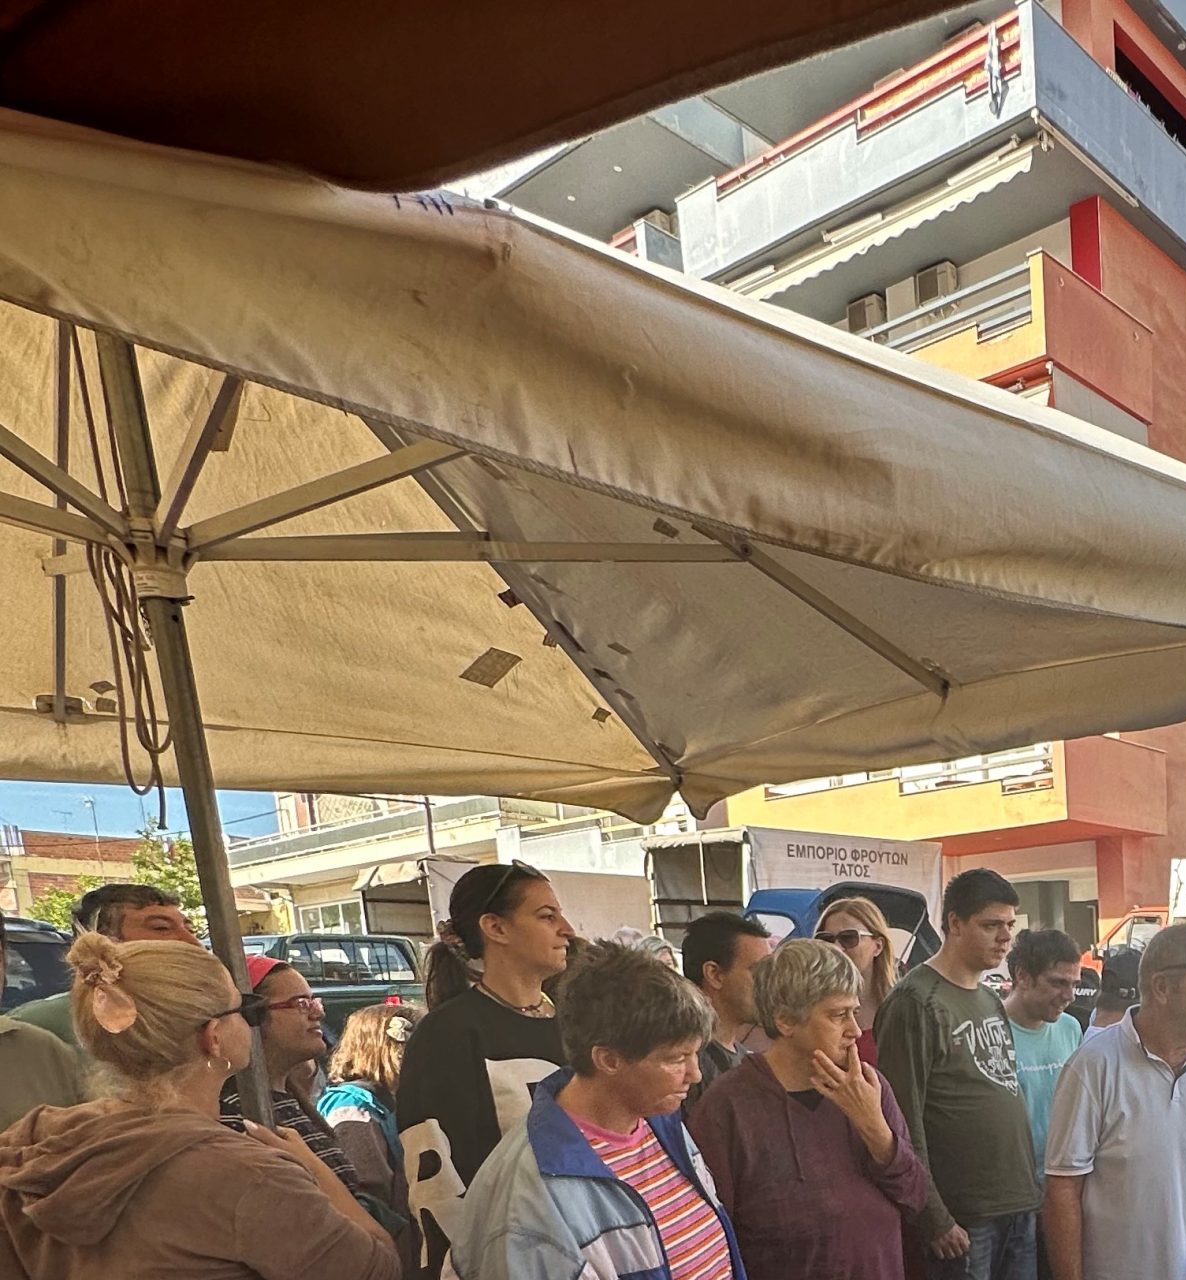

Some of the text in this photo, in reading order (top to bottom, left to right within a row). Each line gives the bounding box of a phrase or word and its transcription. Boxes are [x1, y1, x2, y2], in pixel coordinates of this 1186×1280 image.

[787, 844, 908, 865] ΕΜΠΟΡΙΟ ΦΡΟΥΤΩΝ
[832, 863, 870, 878] ΤΑΤΟΣ
